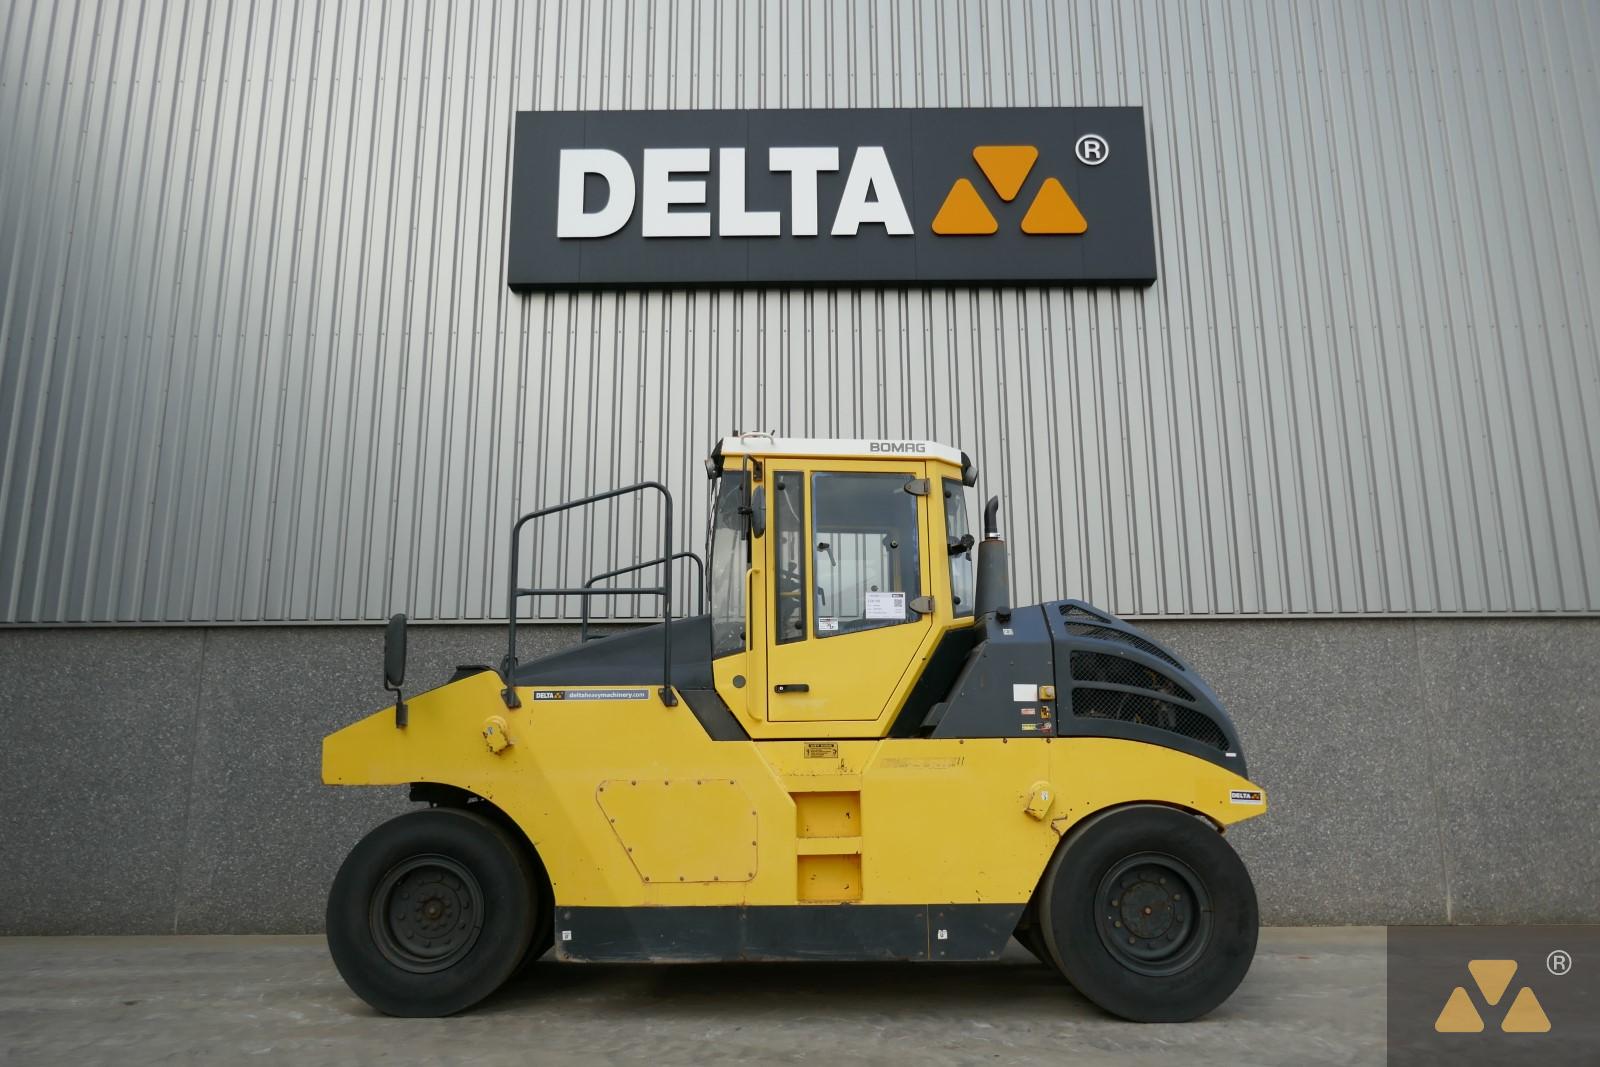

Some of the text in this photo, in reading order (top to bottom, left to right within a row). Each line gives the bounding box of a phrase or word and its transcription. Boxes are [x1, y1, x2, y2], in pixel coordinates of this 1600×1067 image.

[557, 146, 915, 238] DELTA
[870, 442, 926, 453] BOMAG
[569, 691, 645, 700] deltaheavymachinery.com
